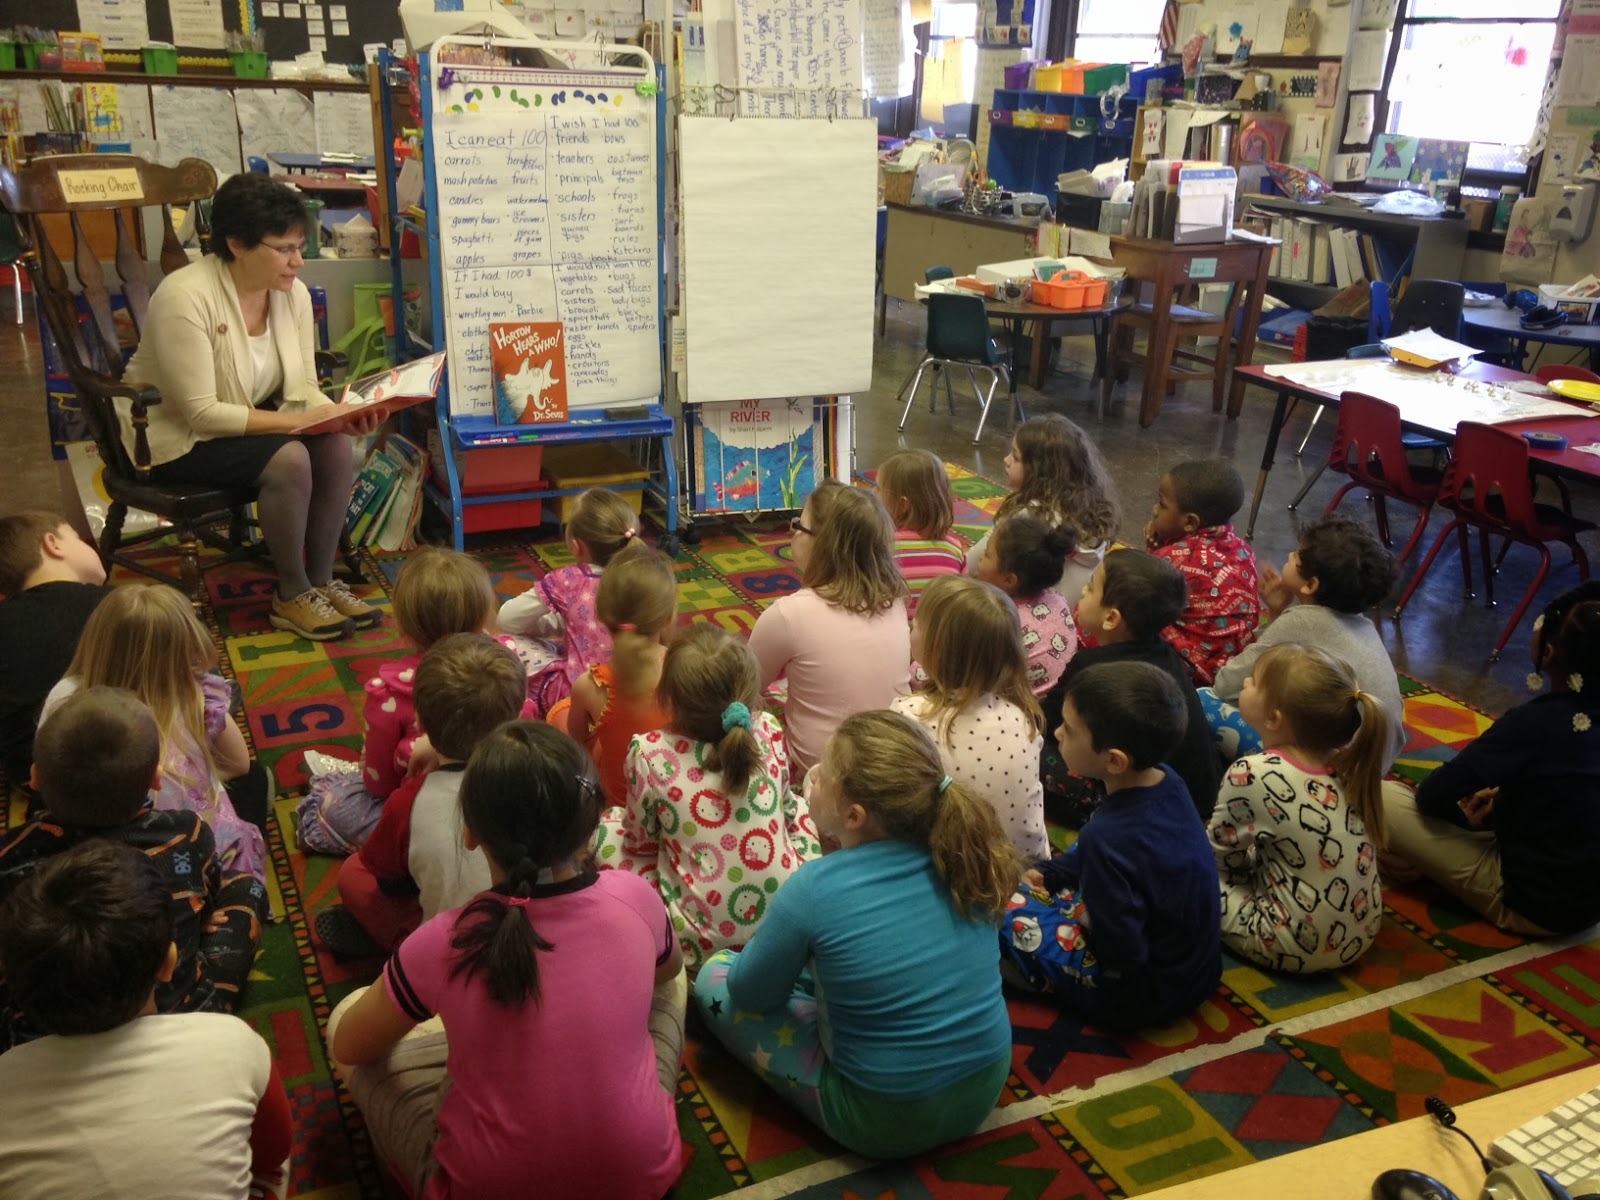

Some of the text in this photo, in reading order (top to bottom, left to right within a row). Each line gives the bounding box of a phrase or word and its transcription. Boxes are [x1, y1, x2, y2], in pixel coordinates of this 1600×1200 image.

[550, 116, 639, 129] I wish I had 100
[445, 129, 547, 146] I can eat 100
[557, 129, 589, 145] friends
[605, 132, 625, 143] bows
[445, 151, 481, 165] carrots
[557, 150, 594, 165] teachers
[444, 171, 466, 185] mash
[512, 170, 539, 185] fruits
[560, 169, 604, 186] principals
[65, 176, 137, 199] Rocking Chair
[613, 186, 638, 203] frogs
[449, 194, 483, 205] candies
[558, 189, 595, 203] schools
[561, 207, 595, 222] sisters
[451, 216, 479, 228] gummy
[452, 231, 494, 248] spaghetti
[456, 252, 485, 268] apples
[512, 252, 541, 261] grapes
[562, 252, 583, 263] pigs
[472, 270, 479, 281] I
[482, 271, 500, 280] had
[455, 285, 512, 303] I would buy
[561, 285, 593, 295] carrots
[459, 307, 490, 321] wrestling
[517, 304, 544, 317] Barbie
[493, 326, 531, 350] HORTON
[512, 332, 540, 356] HEARS
[534, 329, 560, 354] WHO!
[568, 334, 586, 343] eggs
[570, 340, 601, 353] pickles
[471, 399, 493, 409] Trans
[533, 411, 545, 421] Dr.
[730, 411, 771, 422] RIVER
[742, 574, 801, 593] 8
[261, 704, 345, 738] 5
[1411, 991, 1568, 1075] K
